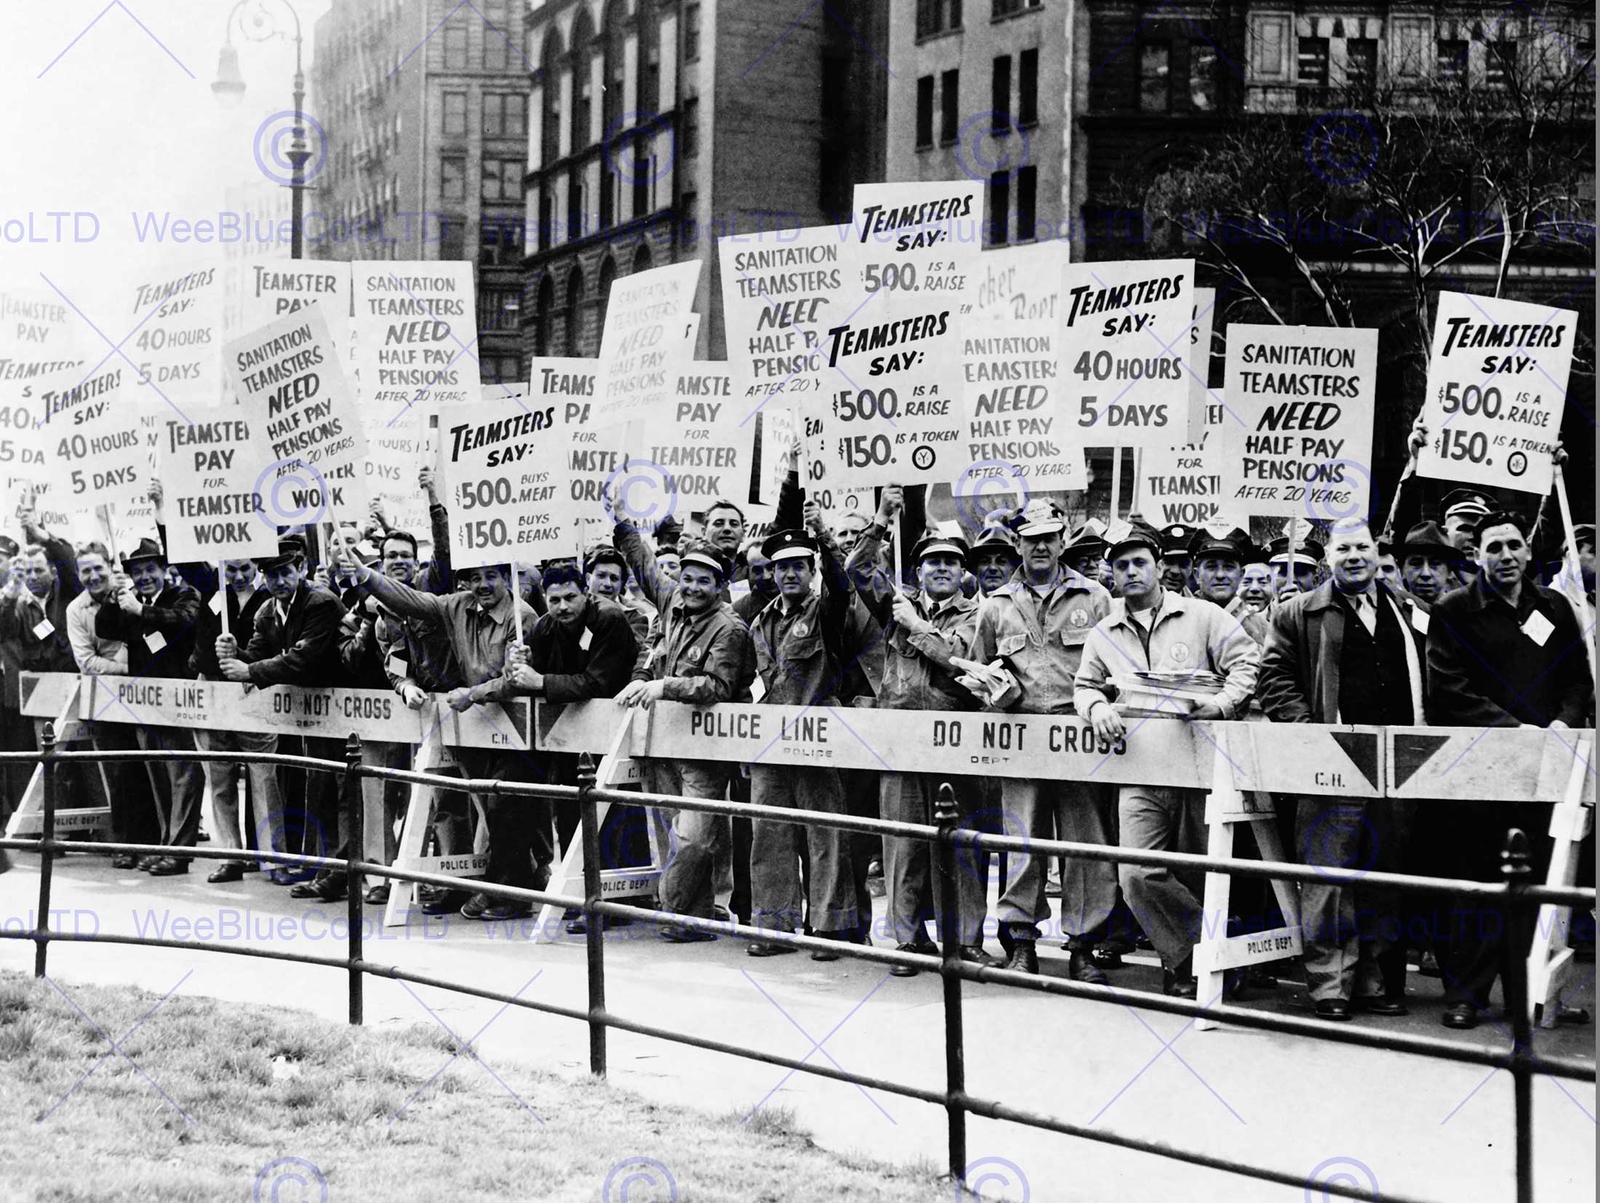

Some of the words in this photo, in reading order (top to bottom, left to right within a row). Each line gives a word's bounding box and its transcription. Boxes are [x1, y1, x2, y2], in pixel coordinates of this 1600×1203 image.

[861, 195, 974, 243] TEAMSTERS
[896, 231, 947, 252] SAY:
[735, 245, 838, 272] SANITATION
[928, 262, 943, 272] IS
[948, 261, 956, 271] A
[133, 268, 215, 315] TEAMSTERS
[253, 266, 337, 298] TEAMSTER
[366, 276, 456, 292] SANITATION
[736, 269, 842, 299] TEAMSTERS
[923, 275, 967, 291] RAISE
[158, 299, 196, 318] SAY:
[367, 298, 465, 316] TEAMSTERS
[1067, 275, 1184, 327] TEAMSTERS
[17, 323, 49, 343] PAY
[385, 320, 450, 346] NEED
[1102, 314, 1156, 337] SAY:
[1442, 317, 1566, 357] TEAMSTERS
[136, 328, 166, 351] 40
[167, 327, 212, 349] HOURS
[236, 324, 313, 373] SANITATION
[748, 332, 796, 355] HALF
[828, 311, 950, 368] TEAMSTERS
[963, 336, 1051, 356] ANITATION
[379, 350, 417, 365] HALF
[424, 350, 456, 364] PAY
[869, 351, 924, 377] SAY:
[1074, 351, 1113, 381] 40
[1116, 357, 1182, 380] HOURS
[1242, 343, 1355, 368] SANITATION
[1481, 356, 1538, 375] SAY:
[137, 362, 152, 386] 5
[158, 362, 201, 383] DAYS
[242, 345, 324, 395] TEAMSTERS
[379, 369, 459, 386] PENSIONS
[267, 373, 321, 418] NEED
[744, 381, 786, 397] AFTER
[789, 378, 810, 392] 20
[913, 386, 928, 397] IS
[931, 385, 938, 395] A
[1240, 372, 1360, 397] TEAMSTERS
[41, 369, 122, 424] TEAMSTERS
[374, 391, 412, 407] AFTER
[414, 388, 430, 401] 20
[434, 390, 468, 402] YEARS
[833, 388, 902, 422] $500.
[905, 399, 951, 416] RAISE
[975, 385, 1048, 417] NEED
[1438, 382, 1504, 421] $500.
[1516, 392, 1530, 403] IS
[1533, 394, 1541, 404] A
[74, 401, 110, 425] SAY:
[267, 413, 302, 441] HALF
[303, 398, 332, 424] PAY
[676, 403, 721, 422] PAY
[1078, 396, 1098, 427] 5
[1107, 404, 1168, 427] DAYS
[1256, 402, 1341, 431] NEED
[1507, 406, 1551, 427] RAISE
[166, 421, 250, 454] TEAMSTE
[271, 418, 343, 460] PENSIONS
[450, 407, 555, 462] TEAMSTERS
[572, 431, 598, 442] FOR
[684, 429, 710, 440] FOR
[895, 433, 907, 444] IS
[909, 433, 918, 443] A
[922, 430, 959, 442] TOKEN
[970, 422, 1012, 438] HALF
[1017, 418, 1053, 437] PAY
[56, 434, 88, 461] 40
[91, 429, 139, 454] HOURS
[838, 434, 897, 468] $150.
[968, 440, 1061, 461] PENSIONS
[1246, 436, 1294, 456] HALF
[1301, 438, 1344, 459] PAY
[1434, 428, 1493, 466] $150.
[1493, 435, 1507, 446] IS
[1509, 438, 1517, 448] A
[194, 449, 235, 472] PAY
[276, 459, 302, 479] AFTER
[306, 449, 324, 465] 20
[324, 436, 355, 457] YEARS
[486, 443, 535, 467] SAY:
[651, 446, 737, 468] TEAMSTER
[1176, 458, 1203, 469] FOR
[71, 470, 86, 494] 5
[93, 466, 137, 490] DAYS
[520, 472, 550, 485] BUYS
[1011, 464, 1029, 479] 20
[1035, 463, 1072, 477] YEARS
[1243, 458, 1345, 483] PENSIONS
[203, 477, 229, 489] FOR
[456, 477, 517, 510] $500.
[518, 485, 556, 503] MEAT
[663, 475, 720, 496] WORK
[1234, 485, 1277, 500] AFTER
[1283, 485, 1305, 501] 20
[1309, 488, 1351, 504] YEARS
[177, 493, 266, 517] TEAMSTER
[518, 514, 549, 526] BUYS
[193, 521, 252, 545] WORK
[459, 518, 512, 549] $150.
[517, 526, 561, 543] BEANS
[118, 684, 162, 706] POLICE
[175, 687, 204, 709] LINE
[273, 692, 291, 713] DO
[304, 694, 331, 717] NOT
[343, 697, 392, 720] CROSS
[691, 711, 761, 739] POLICE
[781, 716, 828, 743] LINE
[933, 720, 962, 748] DO
[983, 721, 1027, 751] NOT
[783, 747, 834, 758] POLICE
[970, 755, 1010, 765] DEPT
[1315, 772, 1346, 788] C.H.
[440, 860, 469, 870] POLICE
[629, 878, 650, 890] DEPT
[1248, 938, 1273, 955] POLICE
[1275, 935, 1294, 951] DEPT
